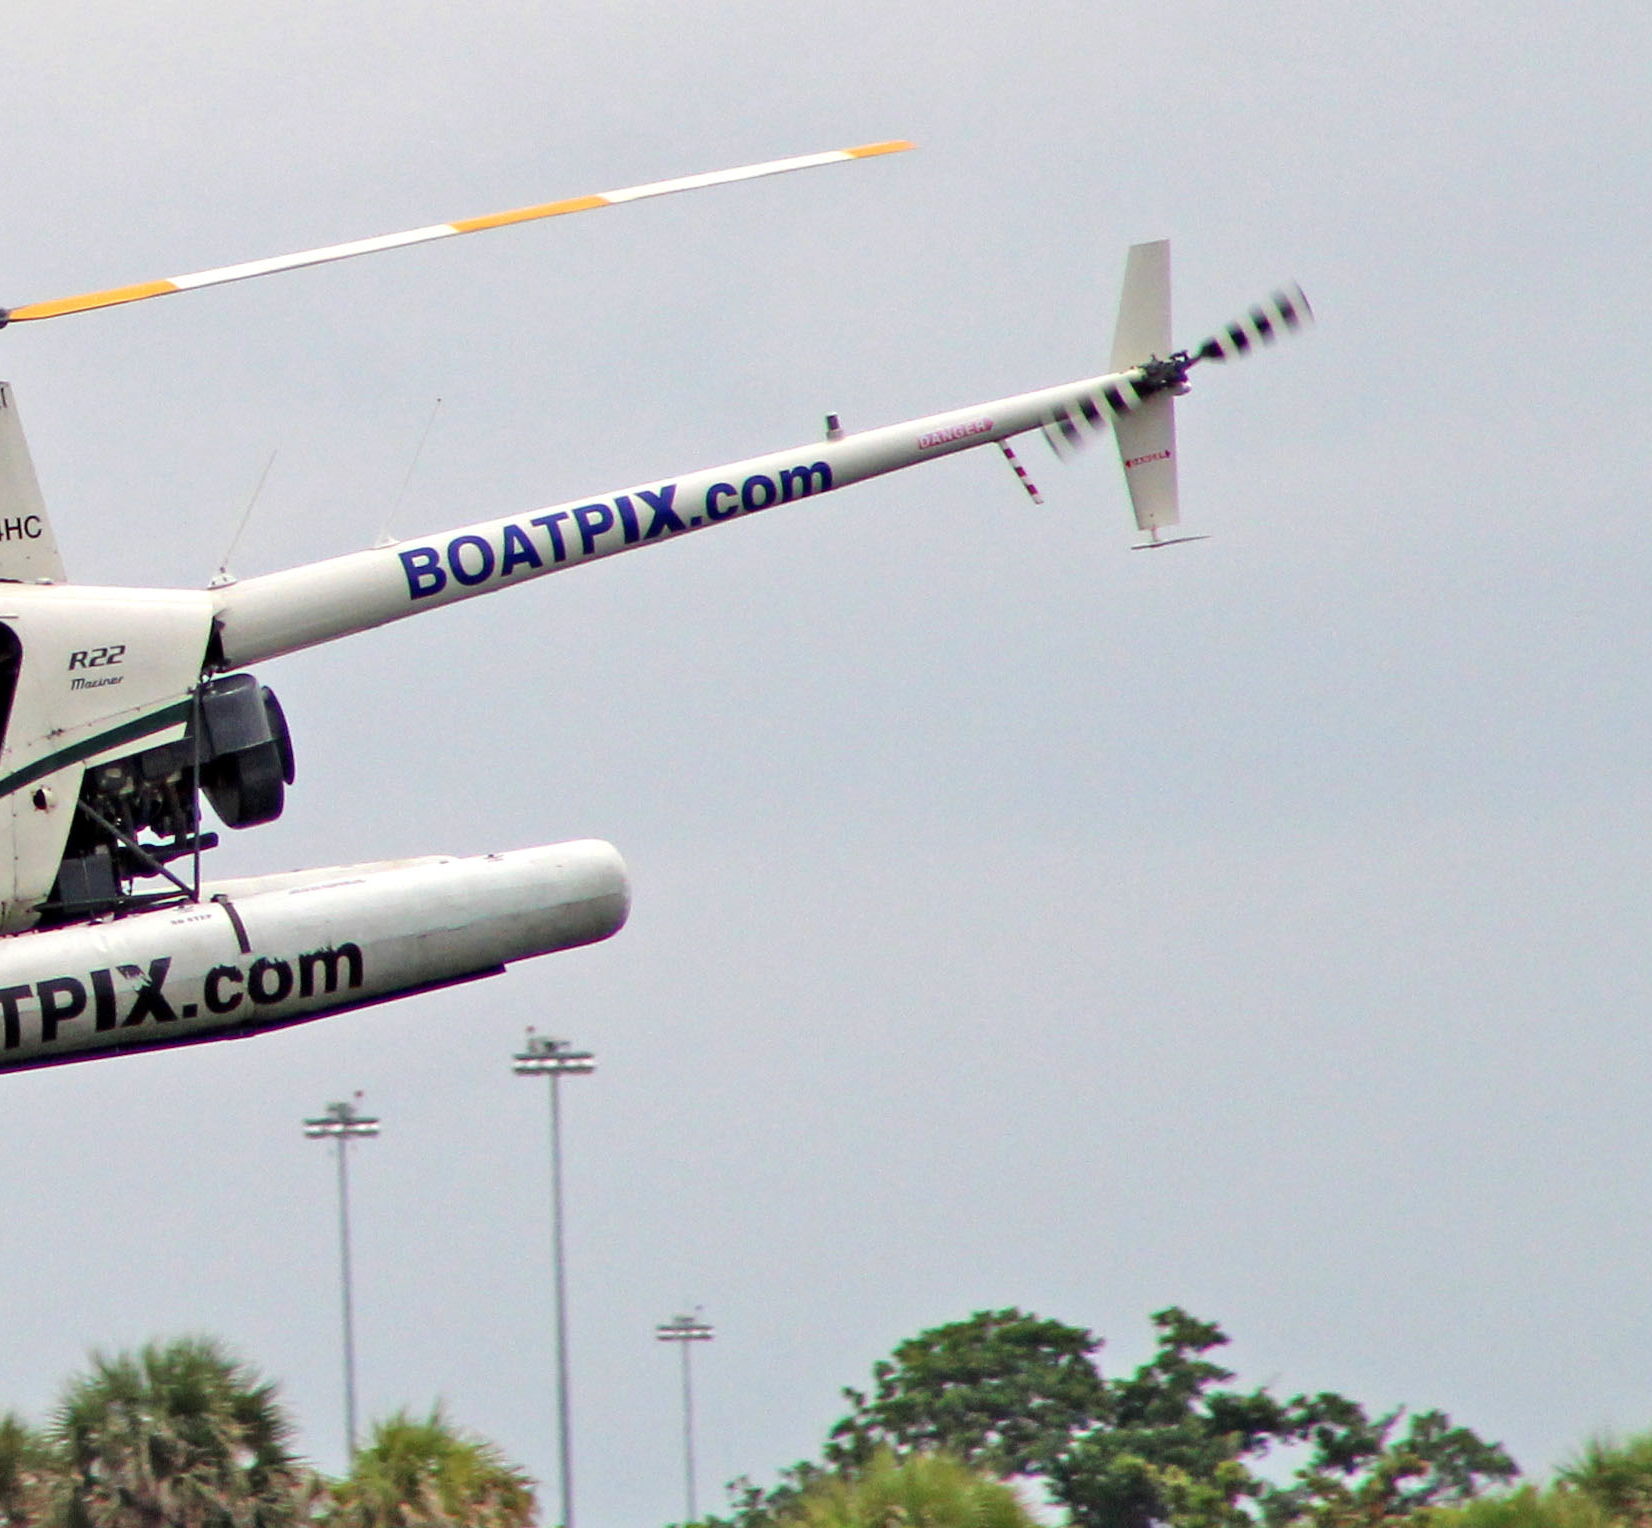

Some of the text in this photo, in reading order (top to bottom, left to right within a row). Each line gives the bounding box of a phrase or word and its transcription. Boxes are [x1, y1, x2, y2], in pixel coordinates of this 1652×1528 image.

[919, 420, 986, 448] DANGER
[398, 460, 834, 600] BOATPIX.com
[68, 645, 126, 671] R22
[70, 676, 125, 691] Mariner
